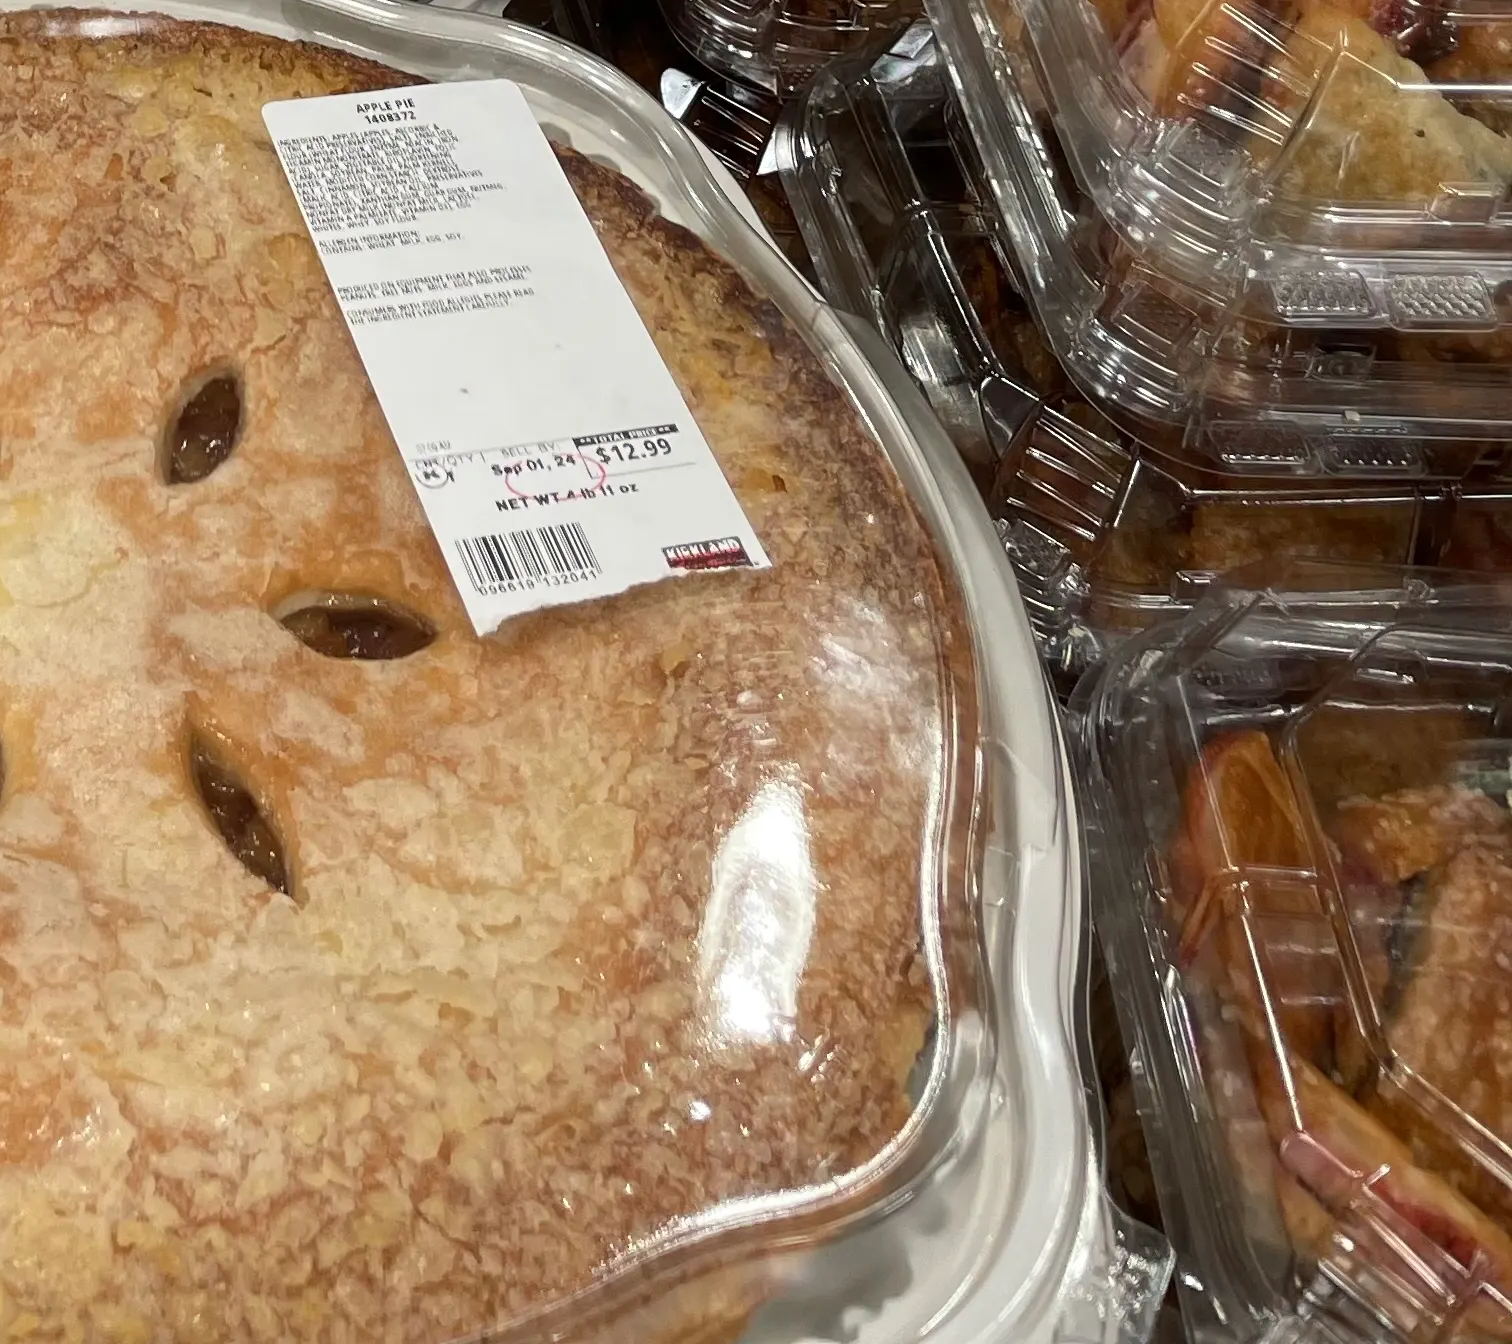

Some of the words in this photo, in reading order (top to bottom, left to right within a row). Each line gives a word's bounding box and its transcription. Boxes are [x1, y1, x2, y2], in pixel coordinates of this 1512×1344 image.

[356, 101, 393, 113] APPLE
[395, 98, 416, 109] PIE
[364, 111, 417, 124] 1408372
[489, 461, 524, 477] Sep
[524, 458, 552, 473] 01,
[552, 454, 578, 466] 24
[593, 437, 675, 464] $12.99
[494, 496, 531, 511] NET
[533, 492, 562, 505] WT
[578, 486, 597, 499] lb
[596, 484, 615, 496] 11
[617, 482, 640, 493] oz
